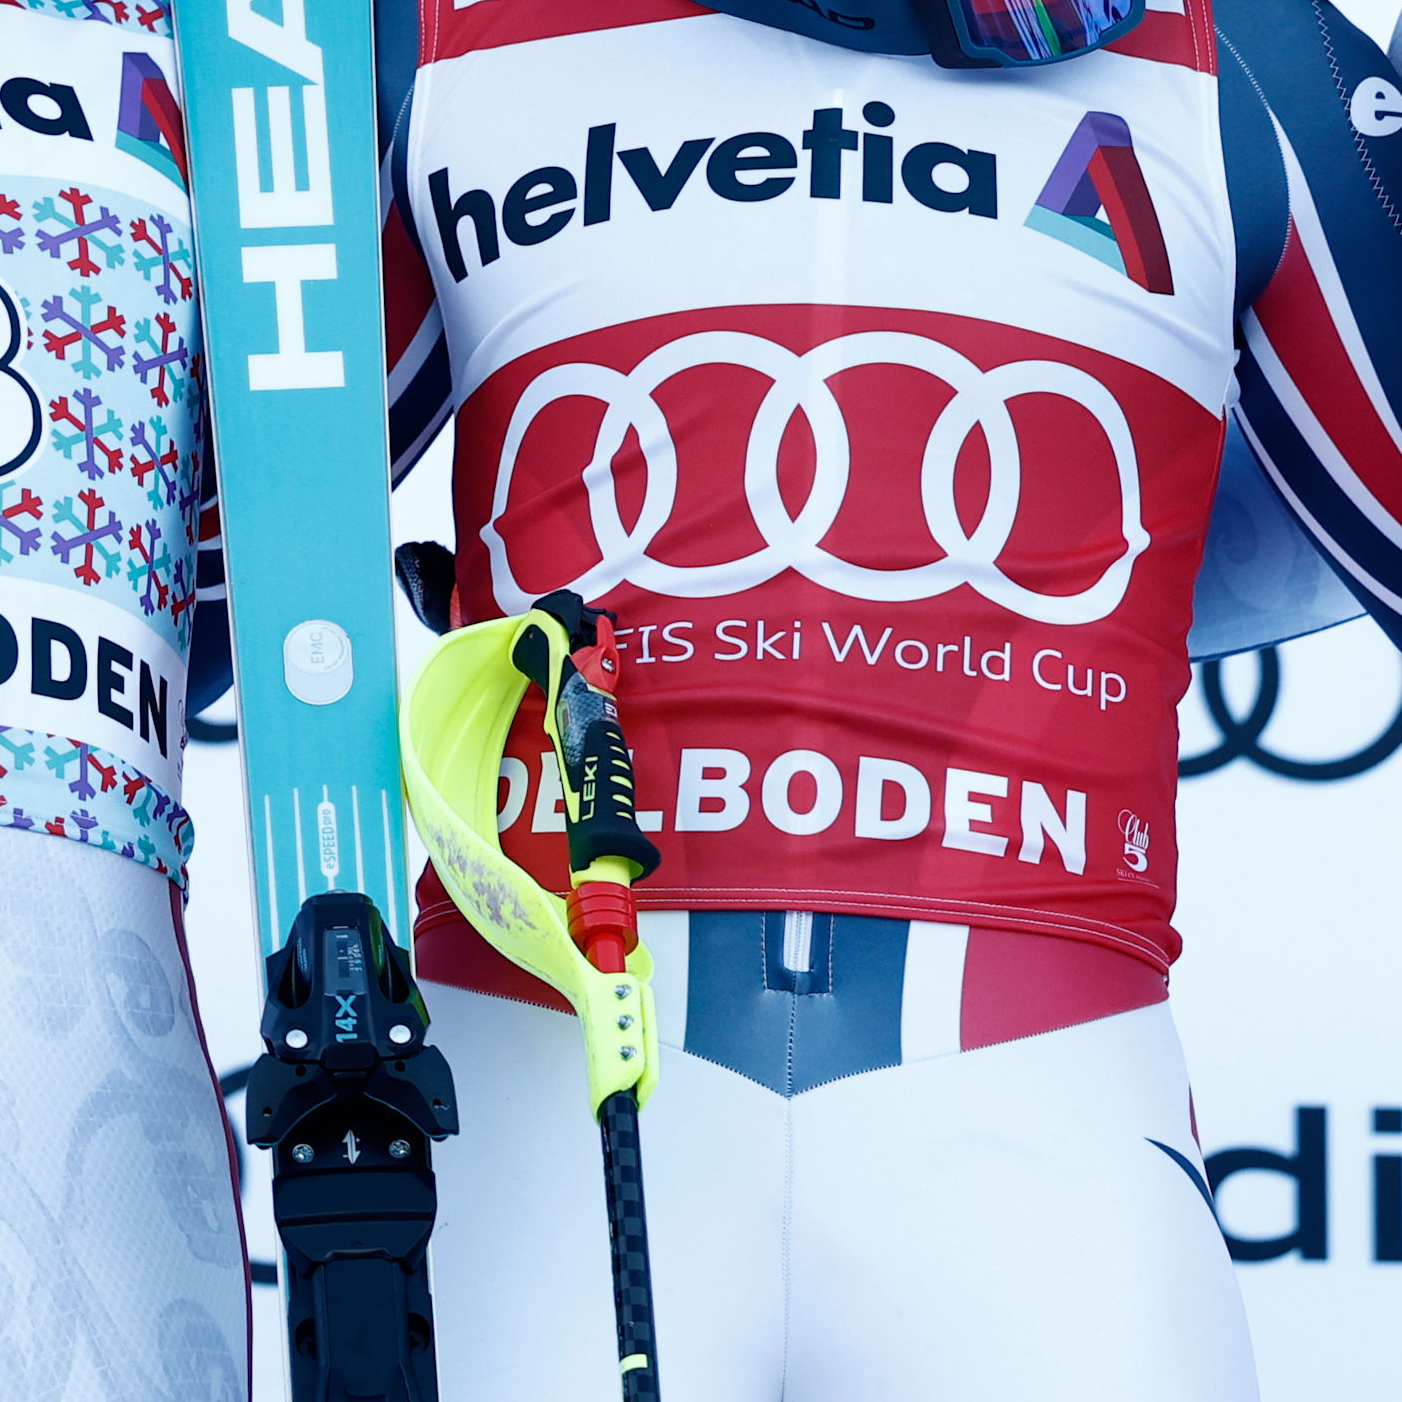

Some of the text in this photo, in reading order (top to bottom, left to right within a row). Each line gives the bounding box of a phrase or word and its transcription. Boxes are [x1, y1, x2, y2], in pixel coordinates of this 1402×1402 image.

[429, 100, 998, 284] helvetia
[310, 631, 325, 665] EMC
[714, 619, 803, 661] Ski
[821, 622, 1012, 683] World
[1032, 648, 1128, 710] Cup
[582, 756, 598, 821] LEKI
[1118, 809, 1149, 850] Club
[1122, 843, 1148, 872] 5
[335, 995, 358, 1043] 14X
